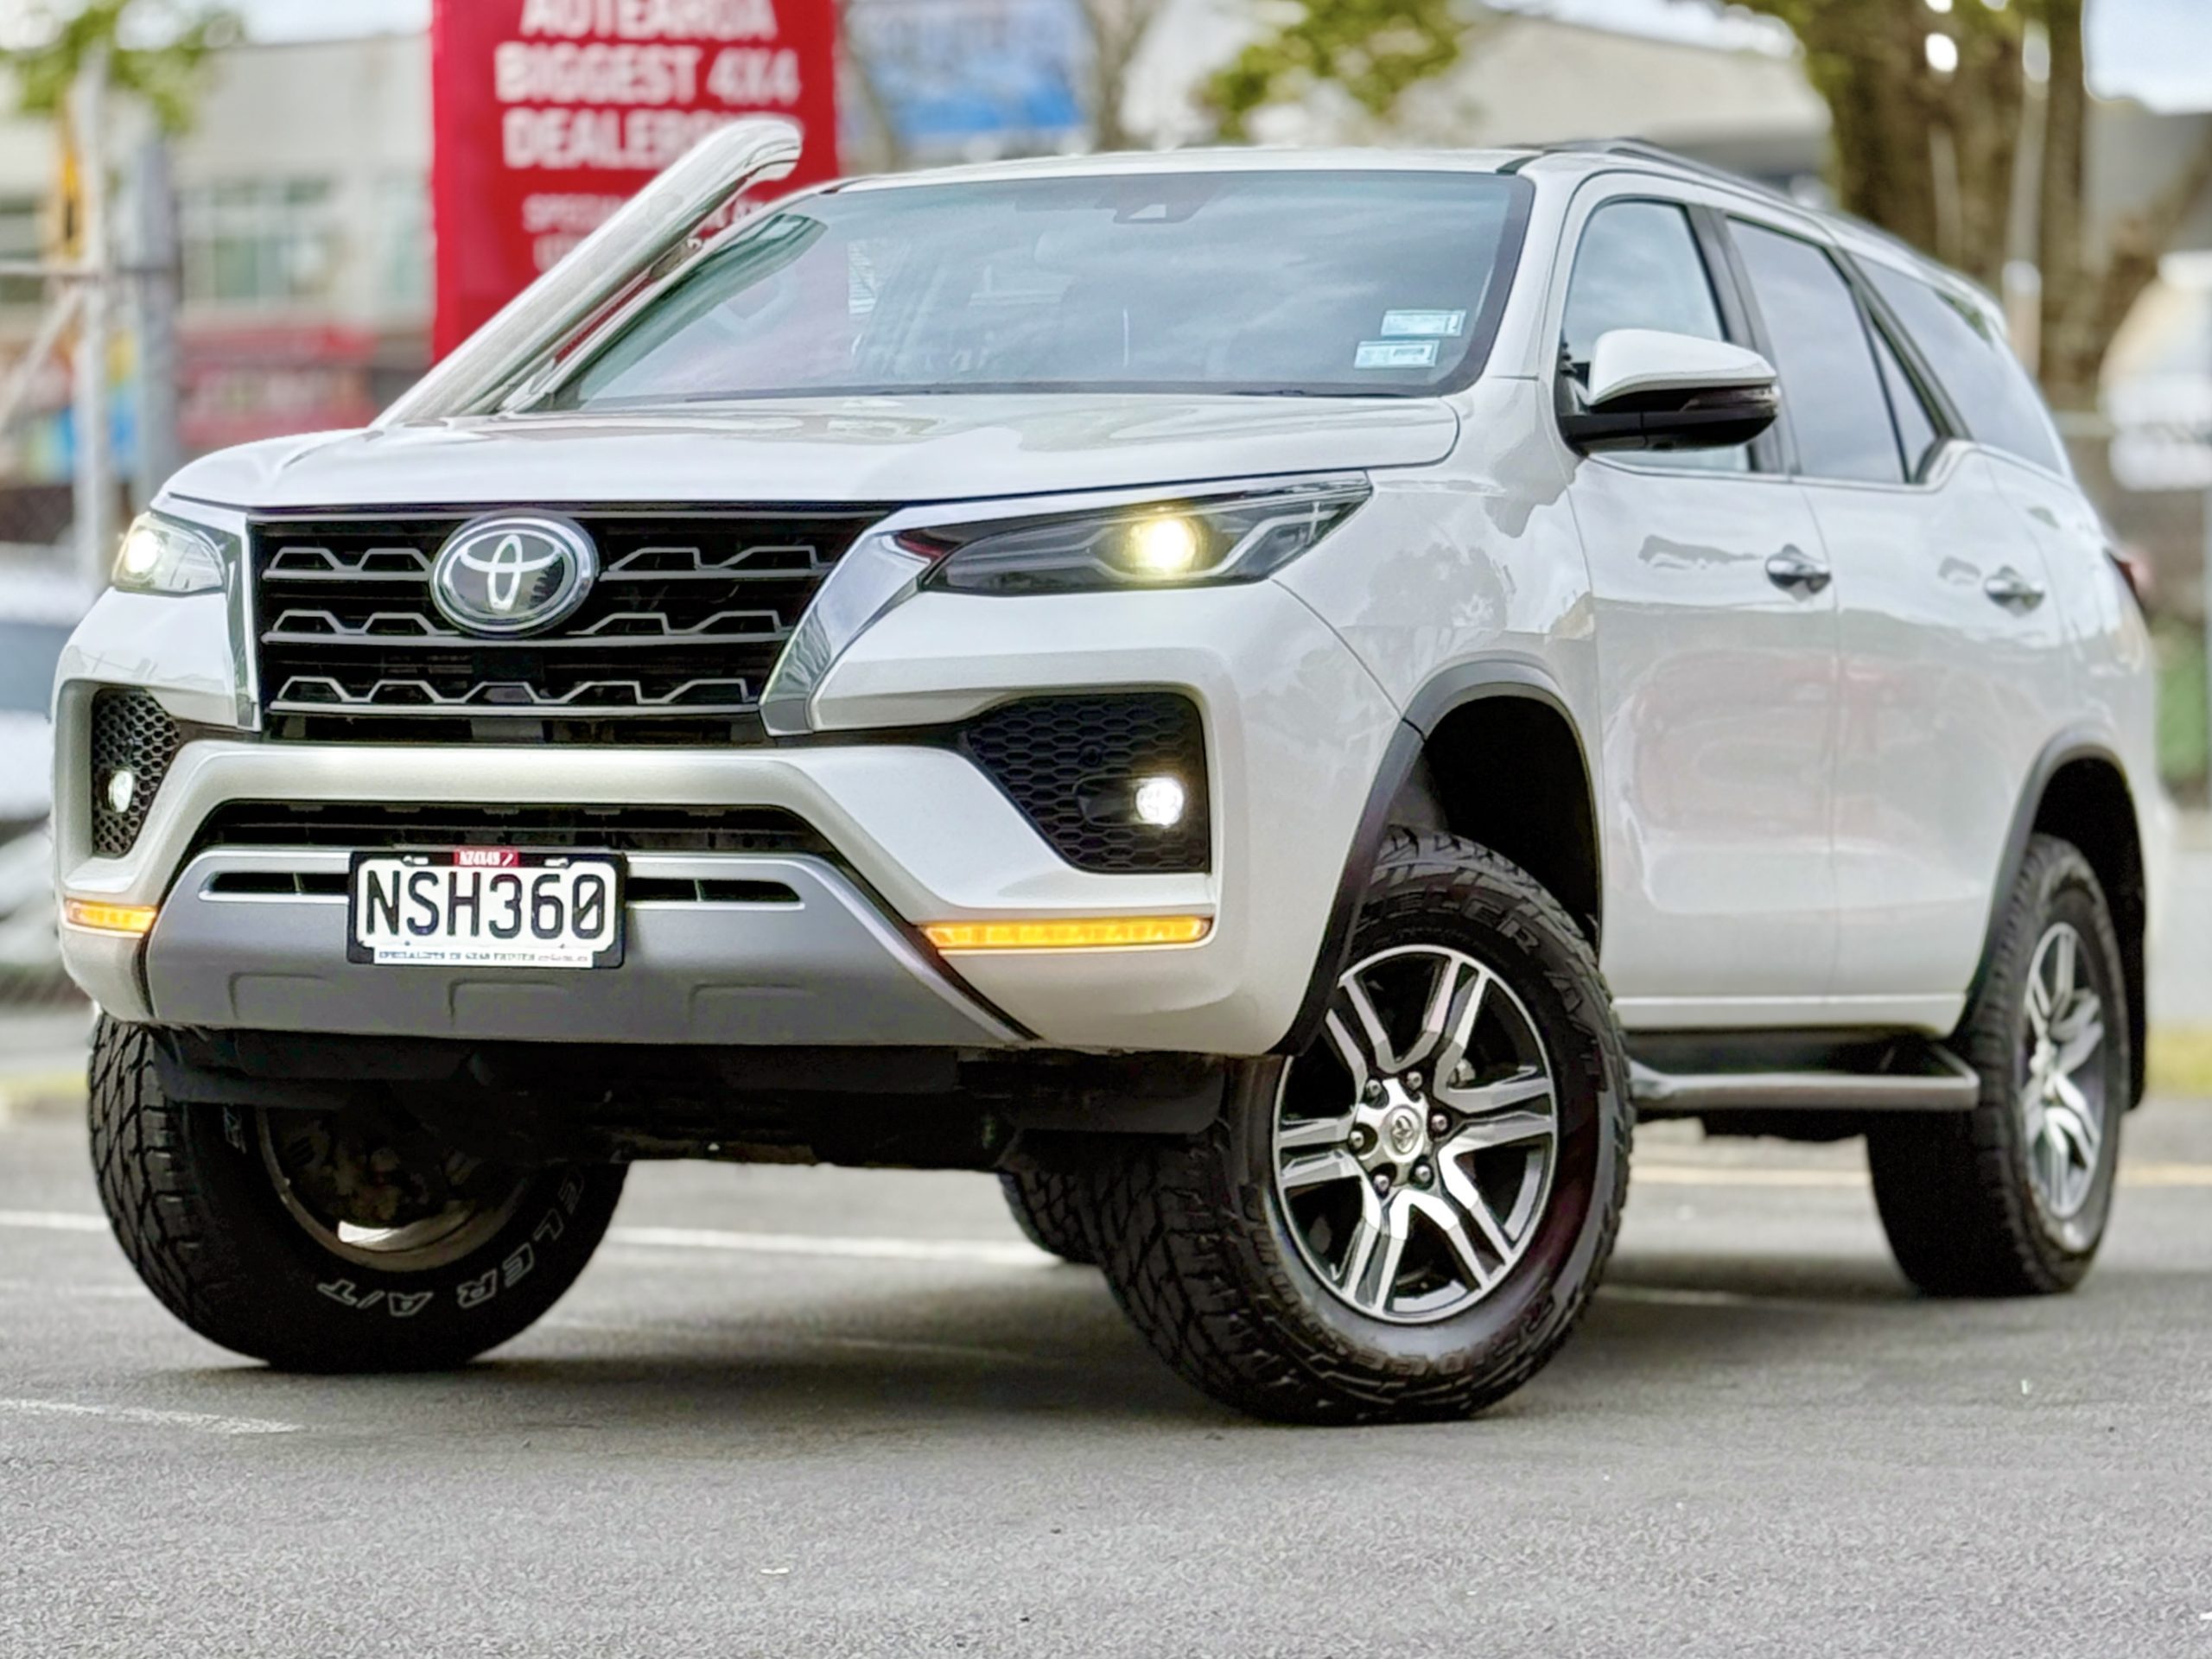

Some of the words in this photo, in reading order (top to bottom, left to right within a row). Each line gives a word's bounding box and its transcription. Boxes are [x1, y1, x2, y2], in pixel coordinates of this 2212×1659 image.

[494, 41, 703, 104] BIGGEST
[707, 48, 800, 105] 4X4
[366, 871, 607, 939] NSH360
